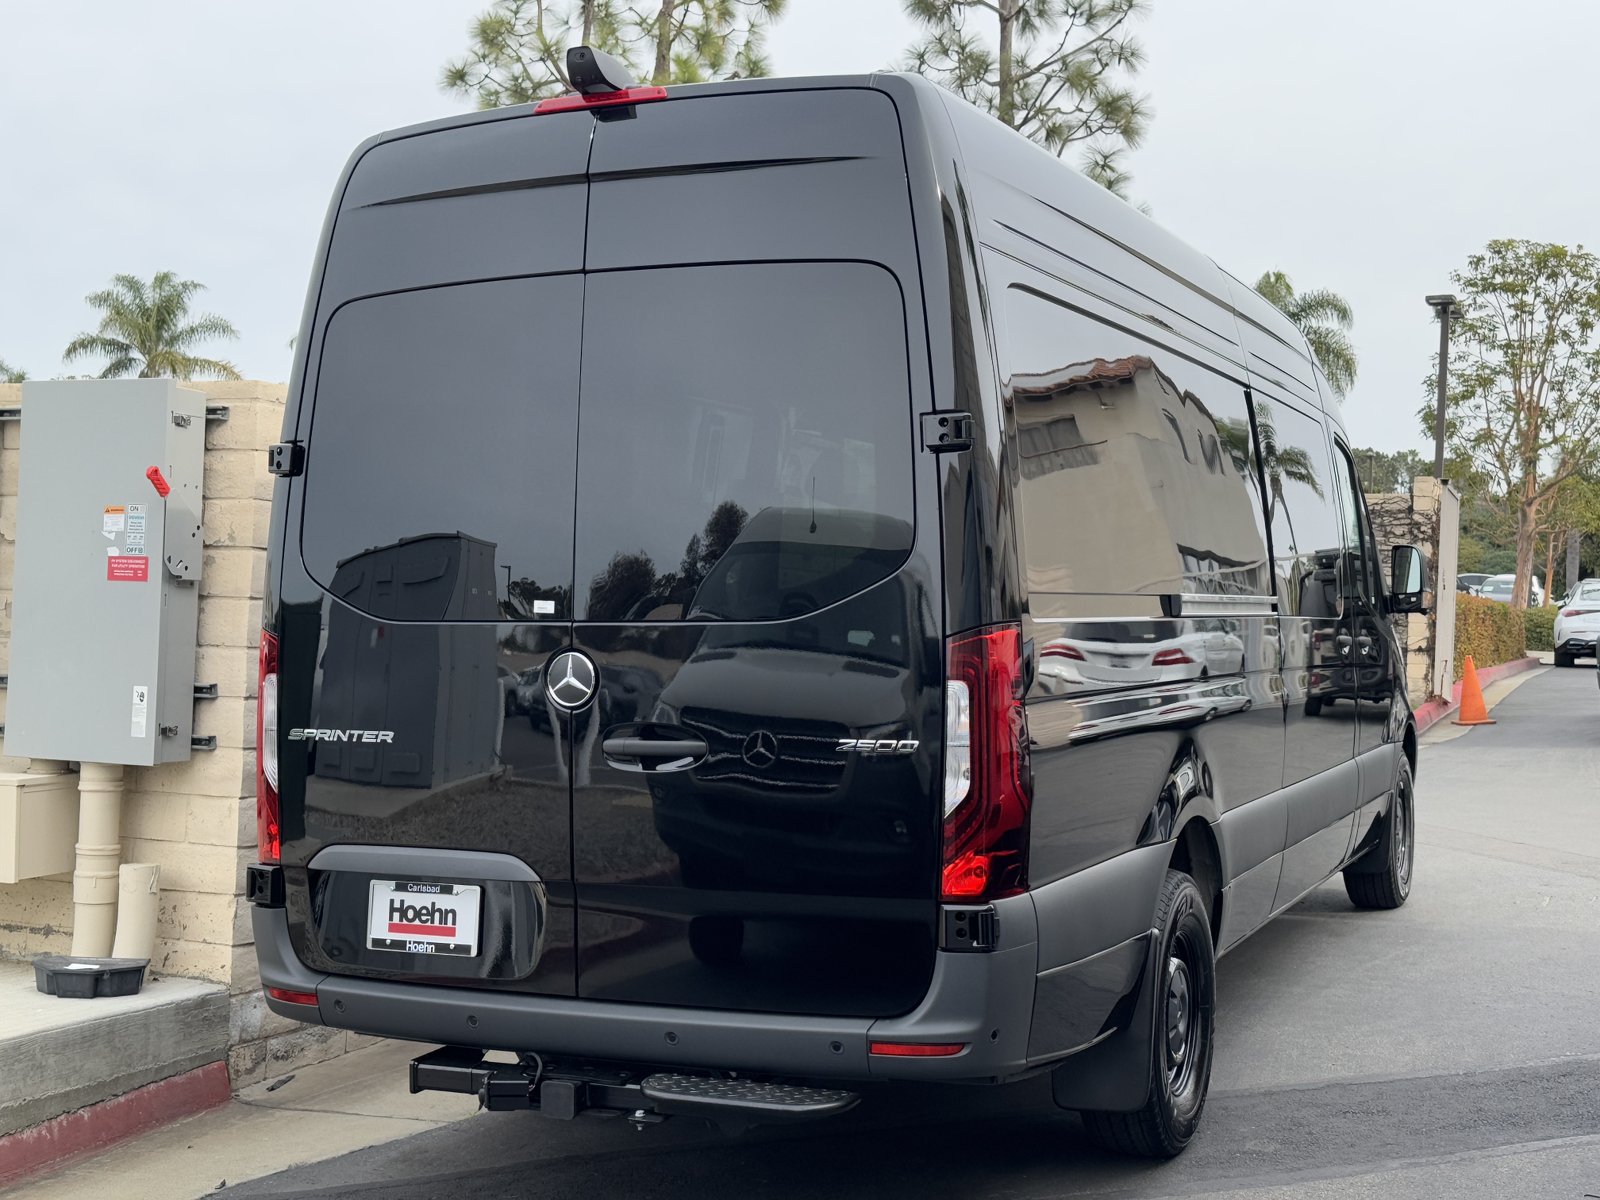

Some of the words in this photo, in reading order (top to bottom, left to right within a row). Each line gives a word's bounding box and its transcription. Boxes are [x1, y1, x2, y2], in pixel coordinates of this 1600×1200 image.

[287, 728, 395, 743] SPRINTER
[835, 739, 920, 752] 2500
[407, 883, 441, 893] Carlsbad
[388, 898, 457, 926] Hoehn
[406, 940, 435, 953] Hoehn
